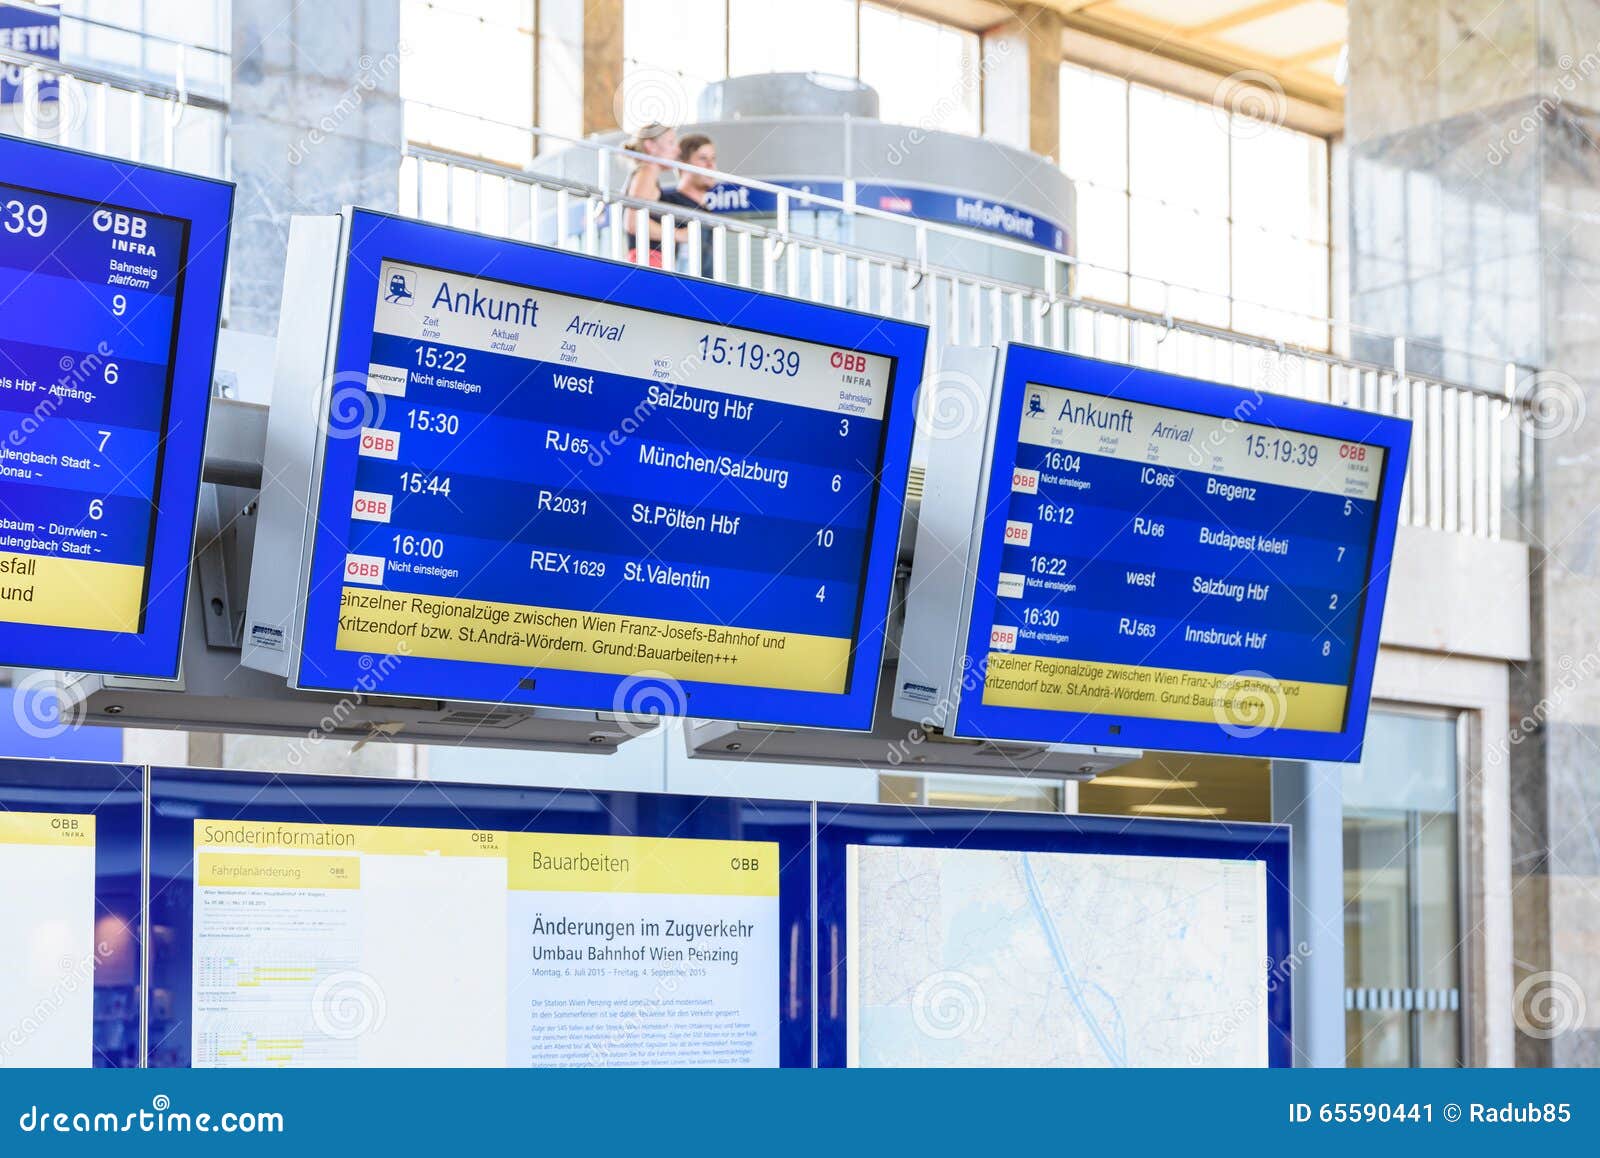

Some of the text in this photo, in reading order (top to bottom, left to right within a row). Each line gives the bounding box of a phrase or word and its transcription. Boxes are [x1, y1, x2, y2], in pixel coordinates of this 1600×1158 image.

[92, 209, 147, 239] ÖBB
[955, 197, 1035, 239] InfoPoint
[111, 238, 157, 257] INFRA
[107, 273, 150, 289] platform
[110, 259, 158, 280] Bahnsteig
[112, 294, 127, 316] 9
[431, 281, 867, 378] Ankunft Arrival 15:19:39 ÖBB
[422, 328, 441, 339] time
[490, 341, 517, 353] actual
[560, 352, 578, 364] train
[422, 315, 440, 328] Zeit
[491, 328, 520, 342] Aktuell
[560, 340, 577, 354] Zug
[839, 390, 873, 406] Bahnsteig
[104, 362, 119, 385] 6
[410, 371, 434, 387] Nicht
[436, 375, 482, 394] einsteigen
[841, 374, 872, 388] INFRA
[15, 378, 36, 393] Hbf
[48, 383, 97, 404] Attnang-
[415, 345, 849, 438] 15:22 west Salzburg Hbf 3
[97, 430, 112, 453] 7
[361, 434, 395, 453] ÖBB
[1058, 398, 1134, 434] Ankunft
[1152, 421, 1194, 443] Arrival
[1246, 433, 1319, 468] 15:19:39
[407, 408, 459, 435] 15:30
[638, 444, 789, 489] München/Salzburg
[831, 474, 842, 493] 6
[60, 455, 92, 470] Stadt
[1040, 473, 1058, 485] Nicht
[1059, 476, 1091, 491] einsteigen
[1045, 451, 1081, 473] 16:04
[1206, 477, 1256, 502] Bregenz
[1343, 499, 1352, 516] 5
[88, 498, 104, 521] 6
[354, 497, 387, 516] ÖBB
[399, 471, 452, 498] 15:44
[710, 513, 741, 536] Hbf
[815, 528, 834, 549] 10
[48, 523, 97, 539] Dürrwien
[1037, 503, 1075, 525] 16:12
[1199, 526, 1256, 551] Budapest
[1258, 537, 1289, 556] keleti
[1337, 546, 1346, 563] 7
[61, 541, 92, 555] Stadt
[0, 557, 36, 576] sfall
[346, 559, 459, 580] ÖBB Nicht einsteigen
[392, 533, 444, 559] 16:00
[623, 561, 711, 590] St.Valentin
[815, 584, 826, 603] 4
[1, 585, 34, 602] und
[1026, 578, 1044, 589] Nicht
[1044, 580, 1077, 593] einsteigen
[1030, 555, 1338, 611] 16:22 west Salzburg Hbf 2
[338, 615, 417, 638] Kritzendorf
[420, 623, 453, 641] bzw.
[339, 592, 786, 650] einzelner Regionalzüge zwischen Wien Franz-Josefs-Bahnhof und
[1023, 607, 1060, 628] 16:30
[1185, 624, 1242, 648] Innsbruck
[1245, 631, 1267, 650] Hbf
[1321, 640, 1331, 657] 8
[1019, 629, 1036, 640] Nicht
[1037, 632, 1069, 643] einsteigen
[1034, 659, 1104, 680] Regionalzüge
[1105, 668, 1151, 684] zwischen
[1154, 671, 1179, 686] Wien
[1283, 685, 1300, 697] und
[1040, 680, 1063, 696] bzw.
[51, 818, 79, 830] ÖBB
[204, 825, 494, 848] Sonderinformation ÖBB
[211, 864, 301, 880] Fahrplanänderung
[532, 851, 760, 874] Bauarbeiten ÖBB
[531, 912, 755, 942] Änderungen im Zugverkehr
[532, 945, 739, 966] Umbau Bahnhof Wien Penzing
[531, 967, 561, 979] Montag,
[573, 967, 586, 978] Juli
[586, 967, 606, 977] 2015
[690, 967, 707, 977] 2015
